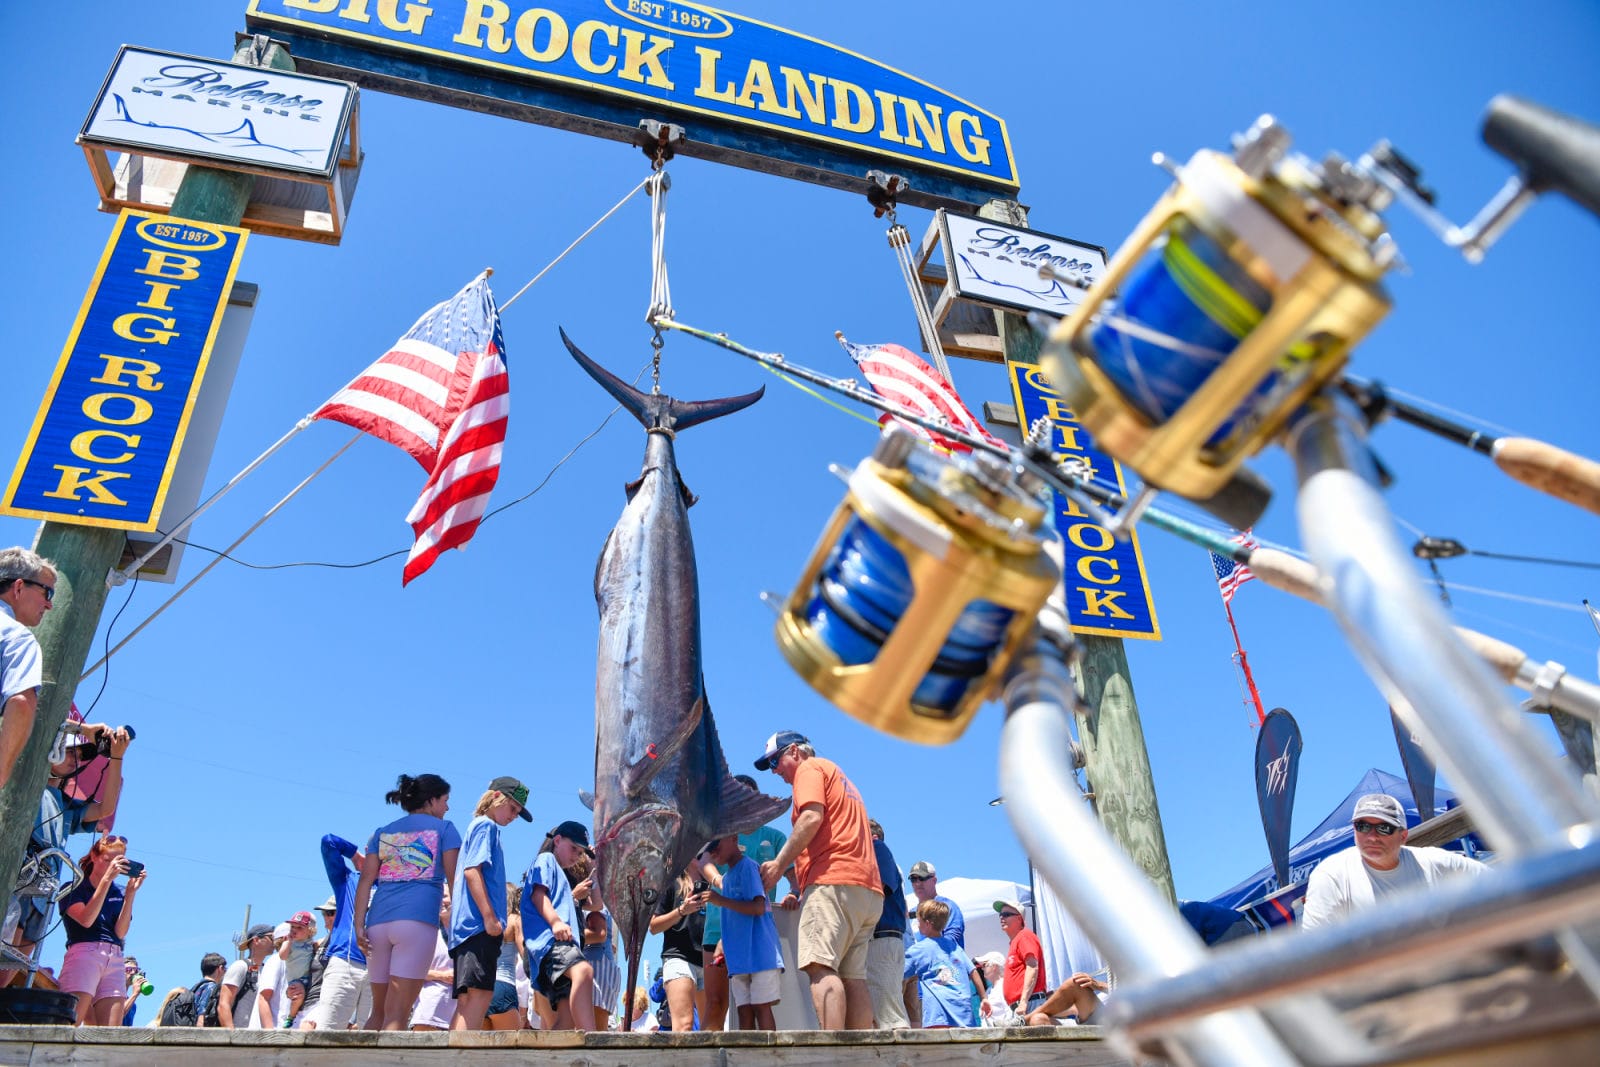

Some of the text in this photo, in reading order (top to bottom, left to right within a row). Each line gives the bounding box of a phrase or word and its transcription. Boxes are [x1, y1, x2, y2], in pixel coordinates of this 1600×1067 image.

[627, 0, 711, 30] EST 1957
[142, 65, 323, 111] Release
[453, 0, 992, 167] ROCK LANDING
[154, 224, 210, 243] EST 1957
[970, 228, 1093, 274] Release
[43, 248, 201, 506] BIG ROCK
